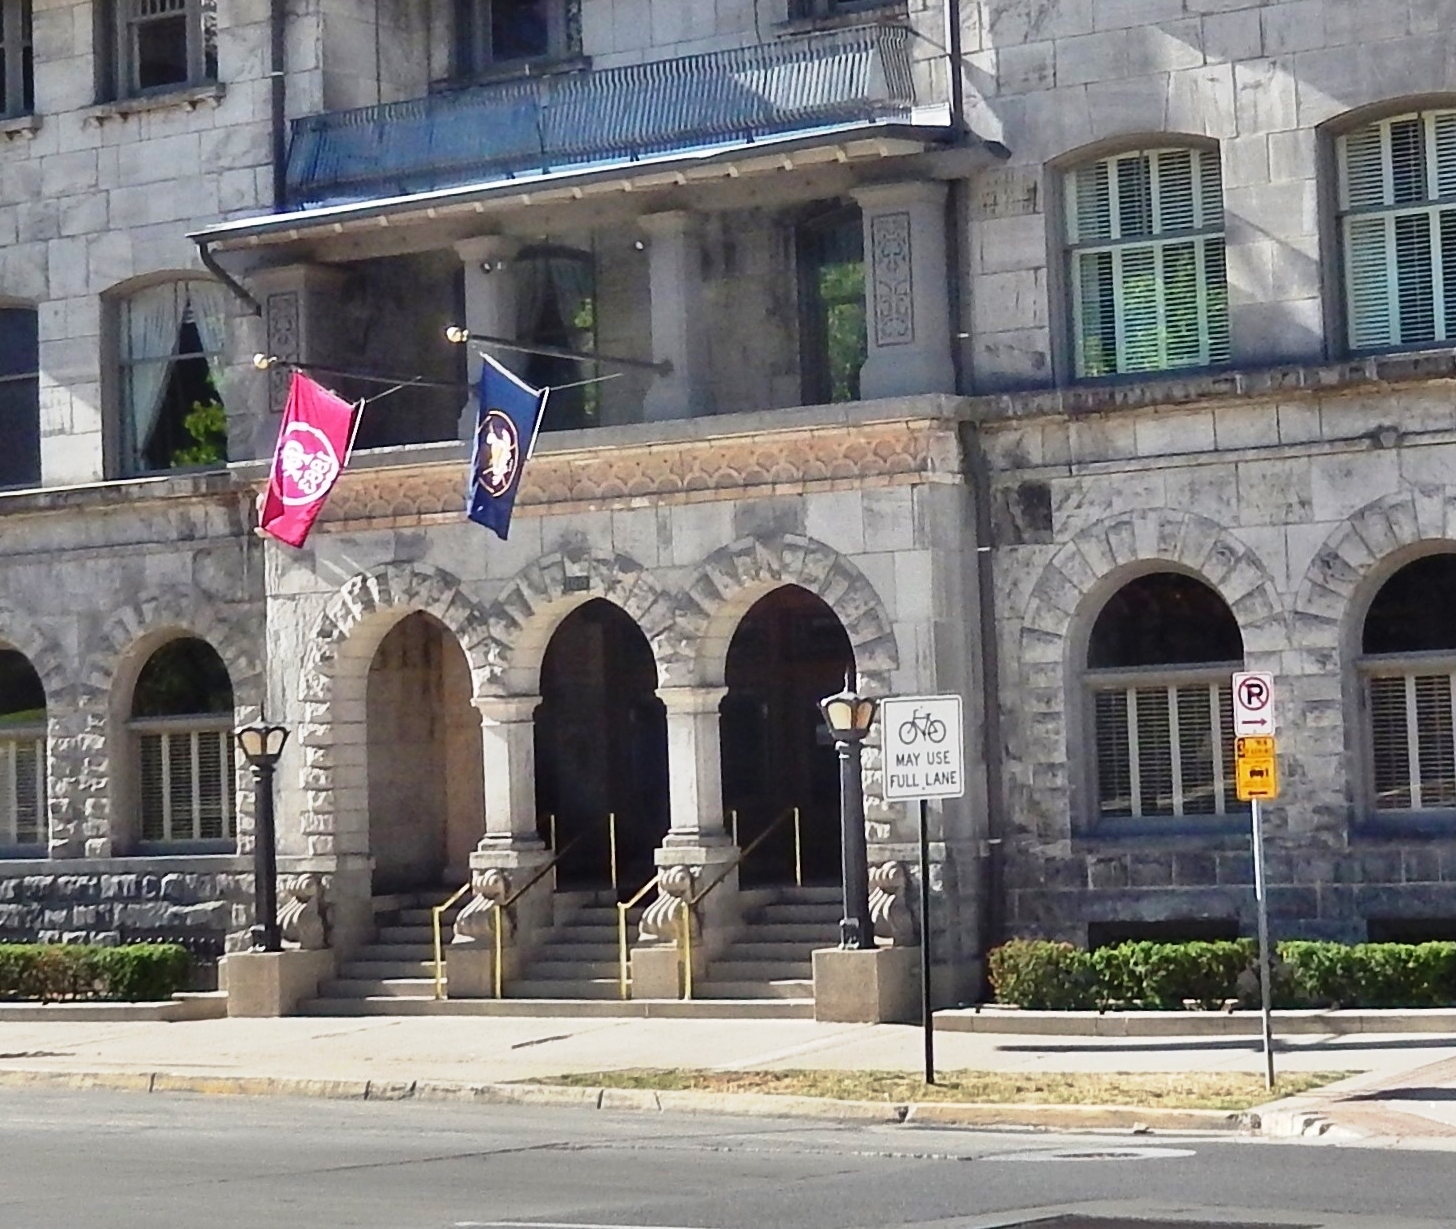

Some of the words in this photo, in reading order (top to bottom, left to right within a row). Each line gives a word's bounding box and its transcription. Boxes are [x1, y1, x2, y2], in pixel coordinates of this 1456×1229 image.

[896, 752, 920, 767] MAY
[927, 750, 950, 765] USE
[890, 773, 919, 789] FULL
[925, 771, 957, 786] LANE
